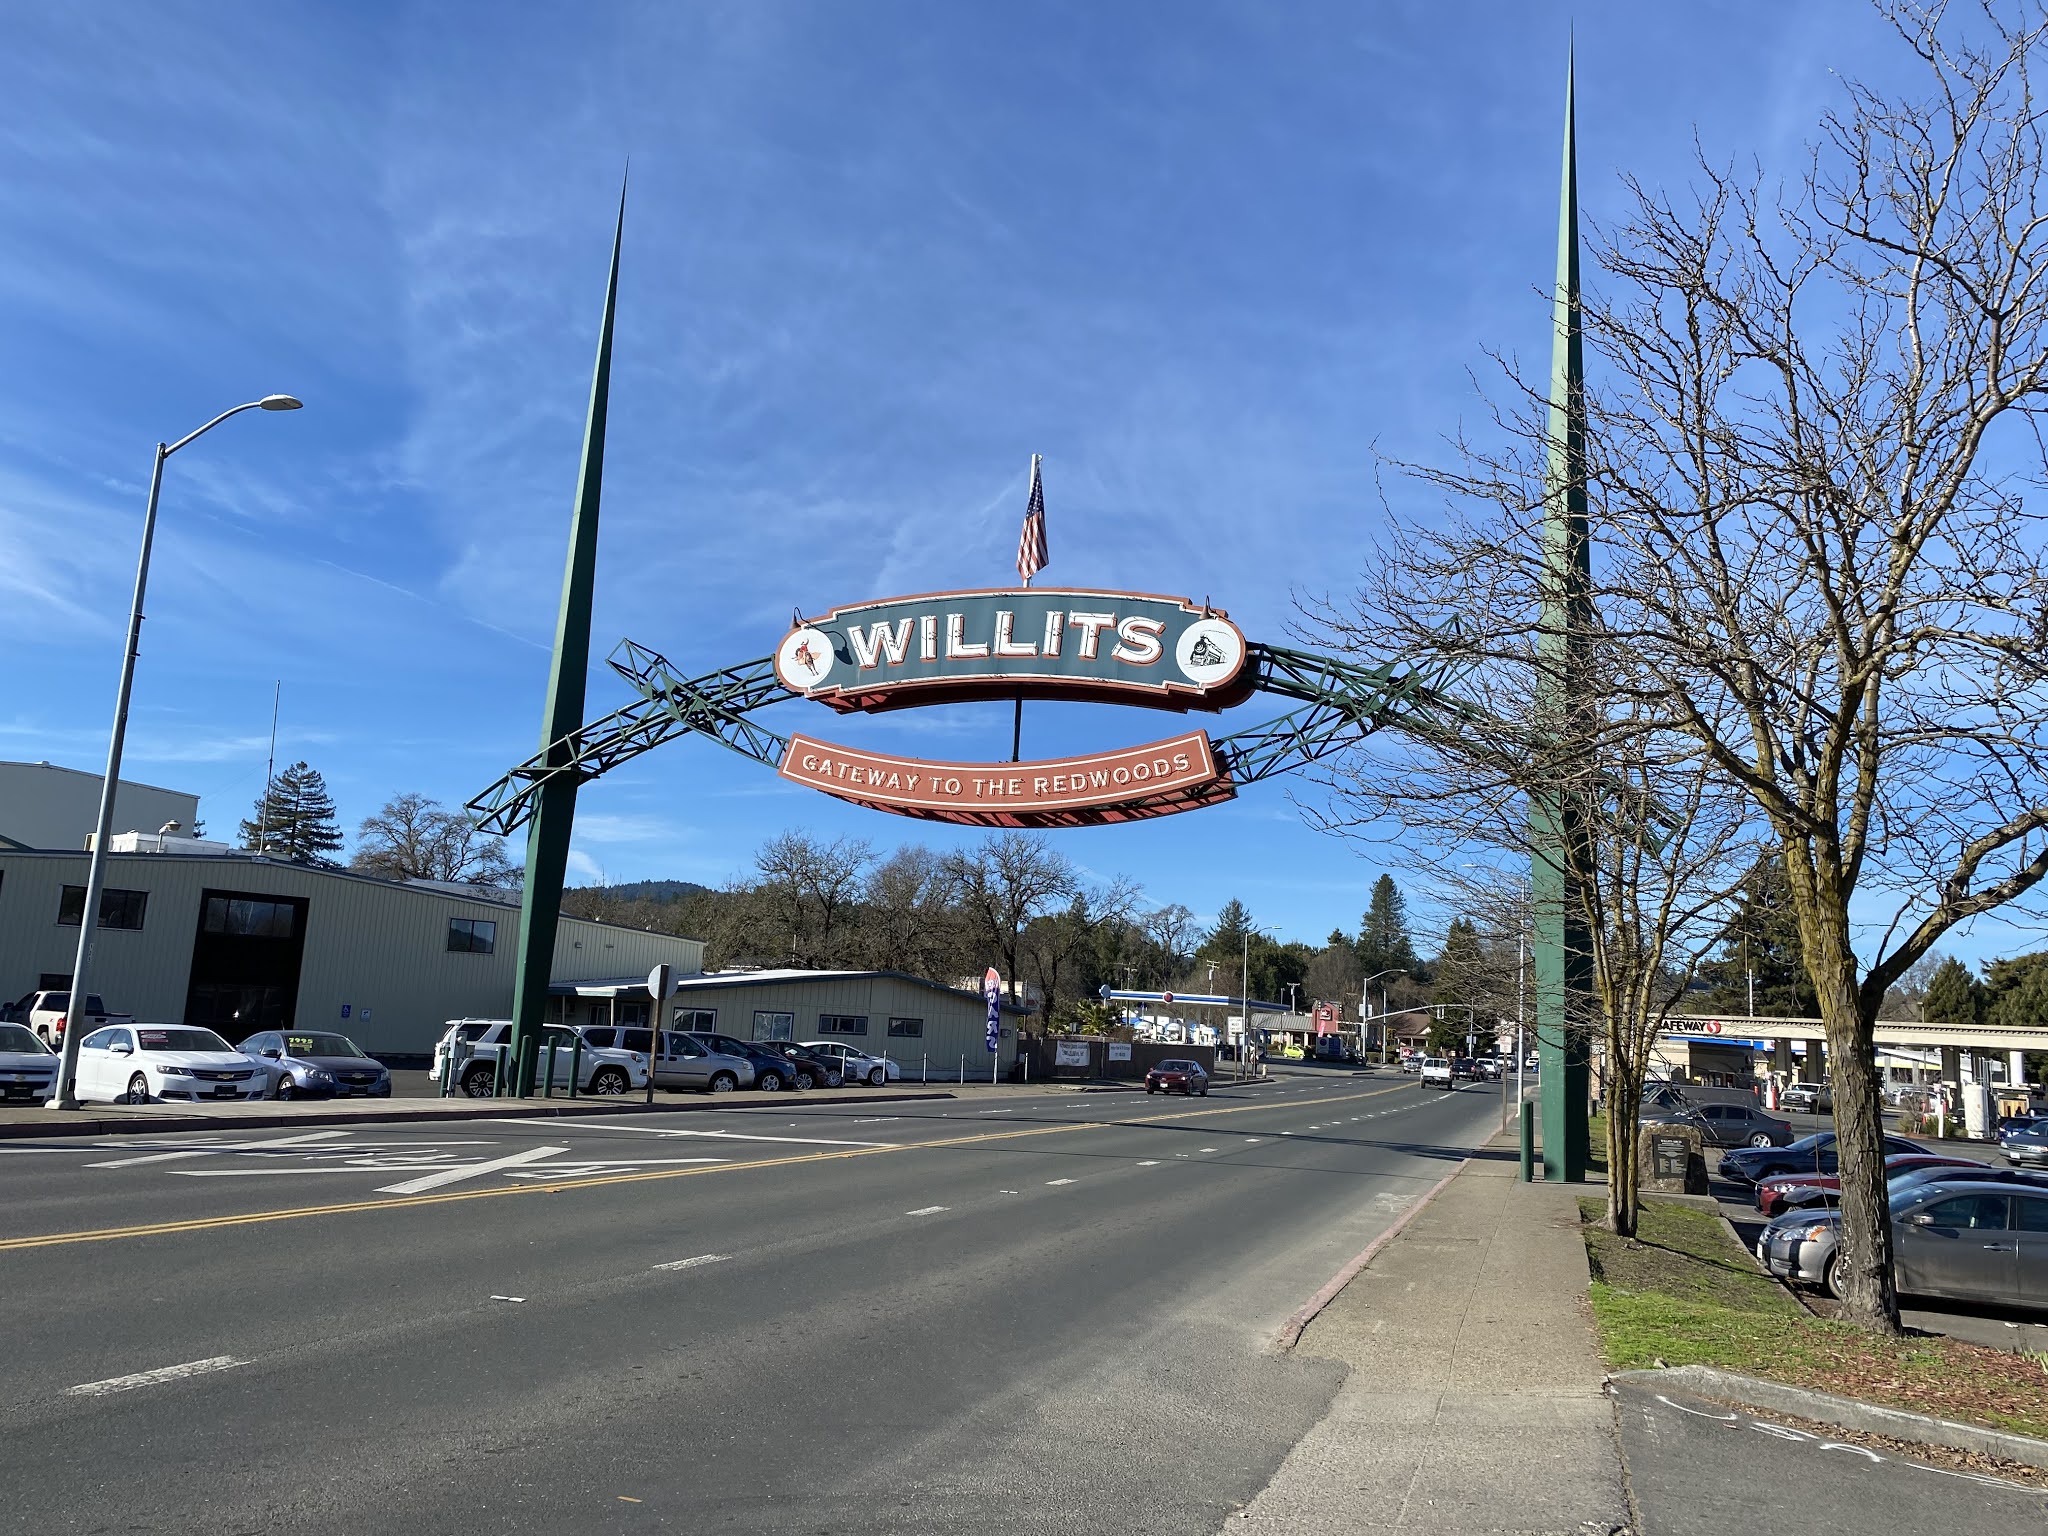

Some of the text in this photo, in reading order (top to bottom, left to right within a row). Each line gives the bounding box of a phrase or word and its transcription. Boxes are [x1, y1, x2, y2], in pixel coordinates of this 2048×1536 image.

[847, 609, 1166, 670] WILLITS
[801, 752, 1192, 797] GATEWAY TO THE REDWOODS
[1659, 1020, 1706, 1032] AFEWAY
